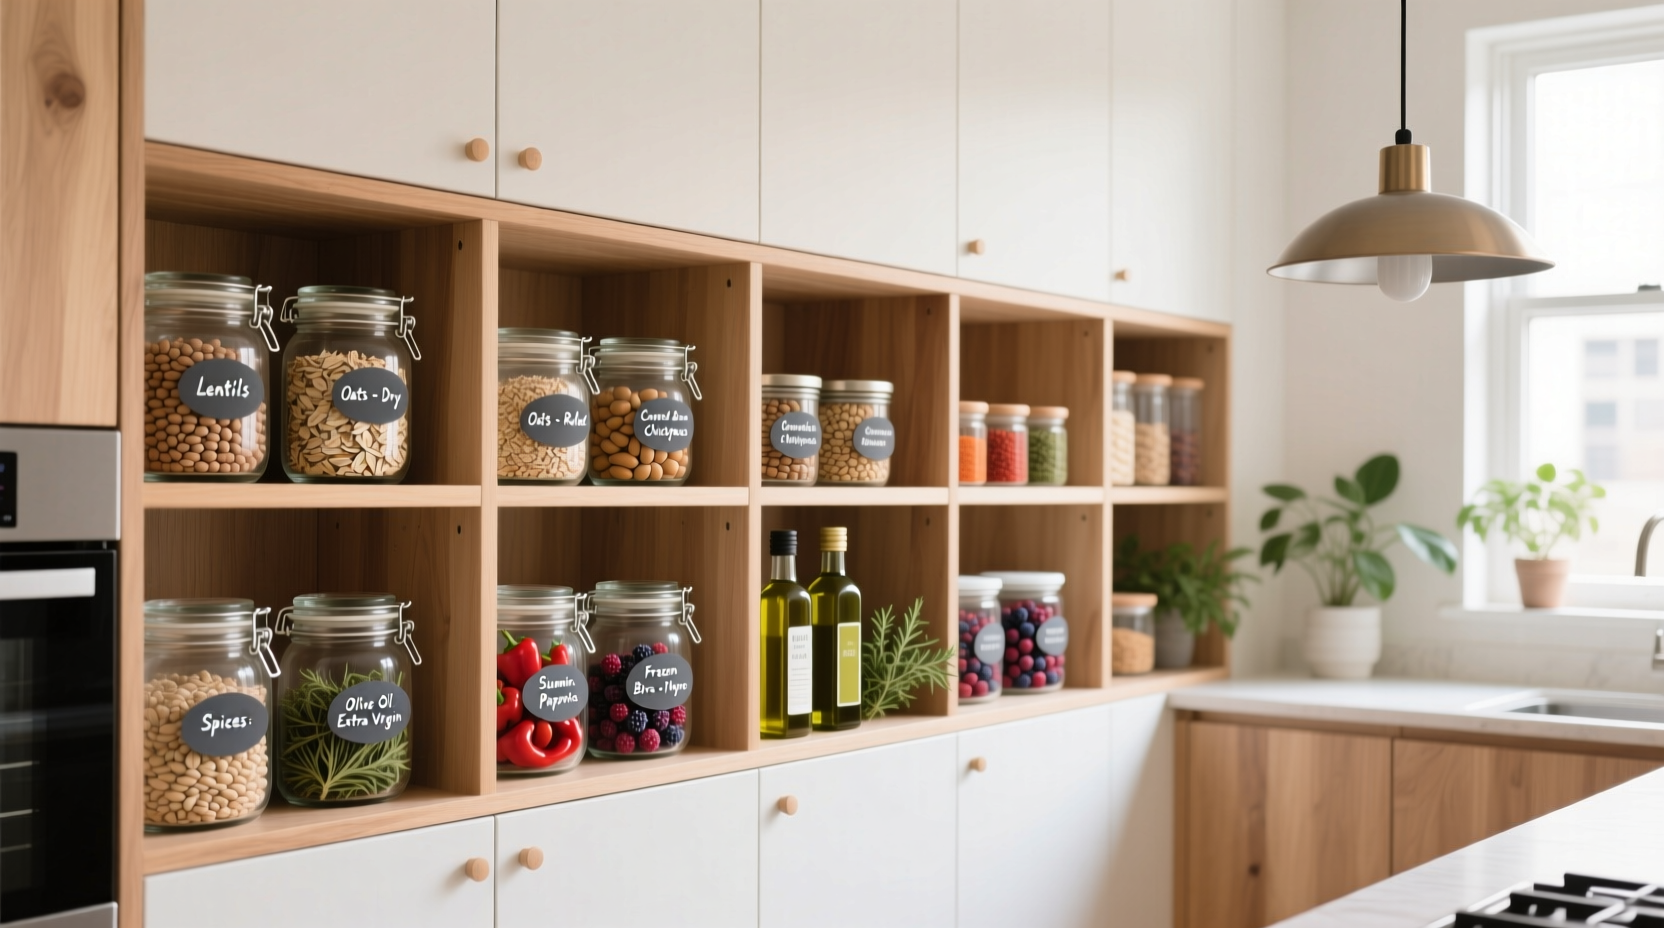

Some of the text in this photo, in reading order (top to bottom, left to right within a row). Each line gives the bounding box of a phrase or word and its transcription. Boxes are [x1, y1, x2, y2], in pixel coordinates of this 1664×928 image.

[196, 375, 250, 398] Lentils
[341, 385, 368, 401] Oats
[381, 386, 402, 410] Dry
[528, 411, 551, 426] Oats
[346, 696, 374, 711] Olive
[337, 713, 368, 728] Extra
